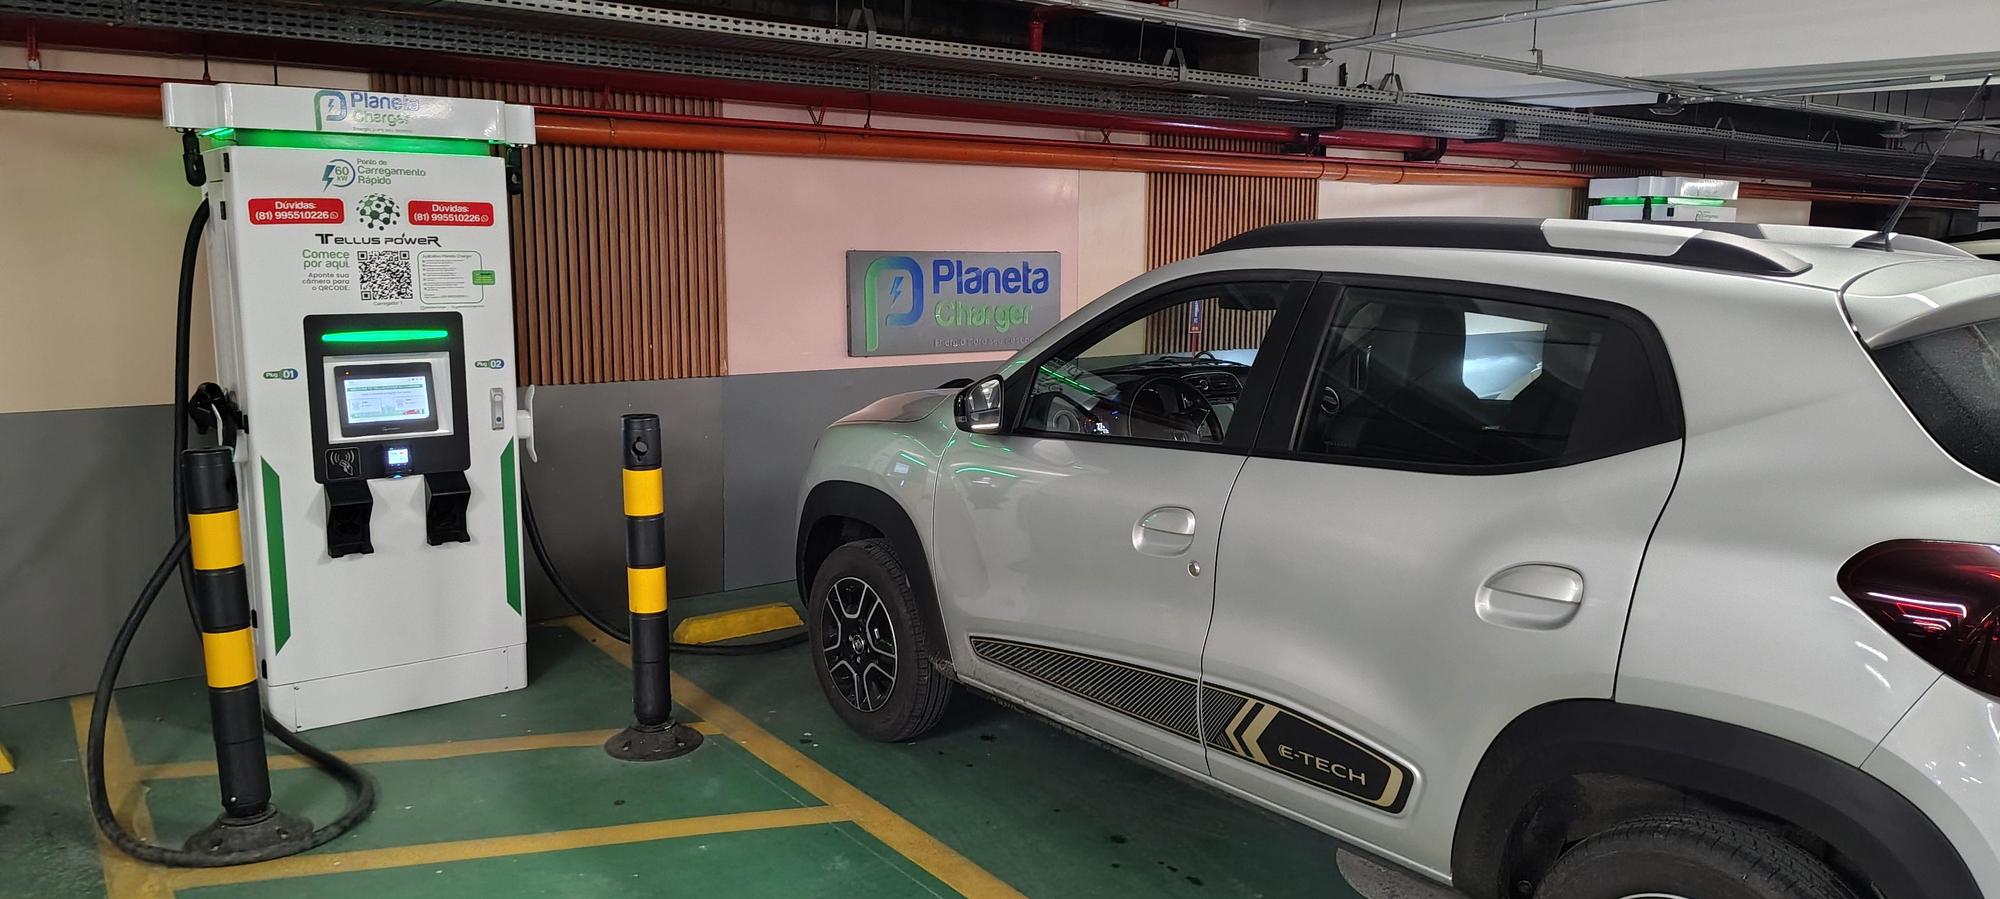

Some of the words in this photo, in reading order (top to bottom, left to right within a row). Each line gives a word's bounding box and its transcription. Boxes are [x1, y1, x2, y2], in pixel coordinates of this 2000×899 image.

[350, 91, 419, 111] Planeta
[352, 109, 410, 127] Charger
[334, 166, 349, 176] 60
[357, 165, 426, 177] Carregamento
[358, 175, 391, 186] Rápido
[275, 201, 317, 210] Dúvidas:
[431, 203, 469, 212] Dúvidas:
[255, 211, 273, 221] (81)
[413, 212, 430, 222] (81)
[302, 249, 350, 259] Comece
[303, 260, 322, 270] por
[932, 259, 1050, 295] Planeta
[934, 300, 1032, 333] Charger
[490, 360, 502, 368] 02
[283, 370, 295, 378] 01
[1278, 744, 1366, 786] E-TECH
